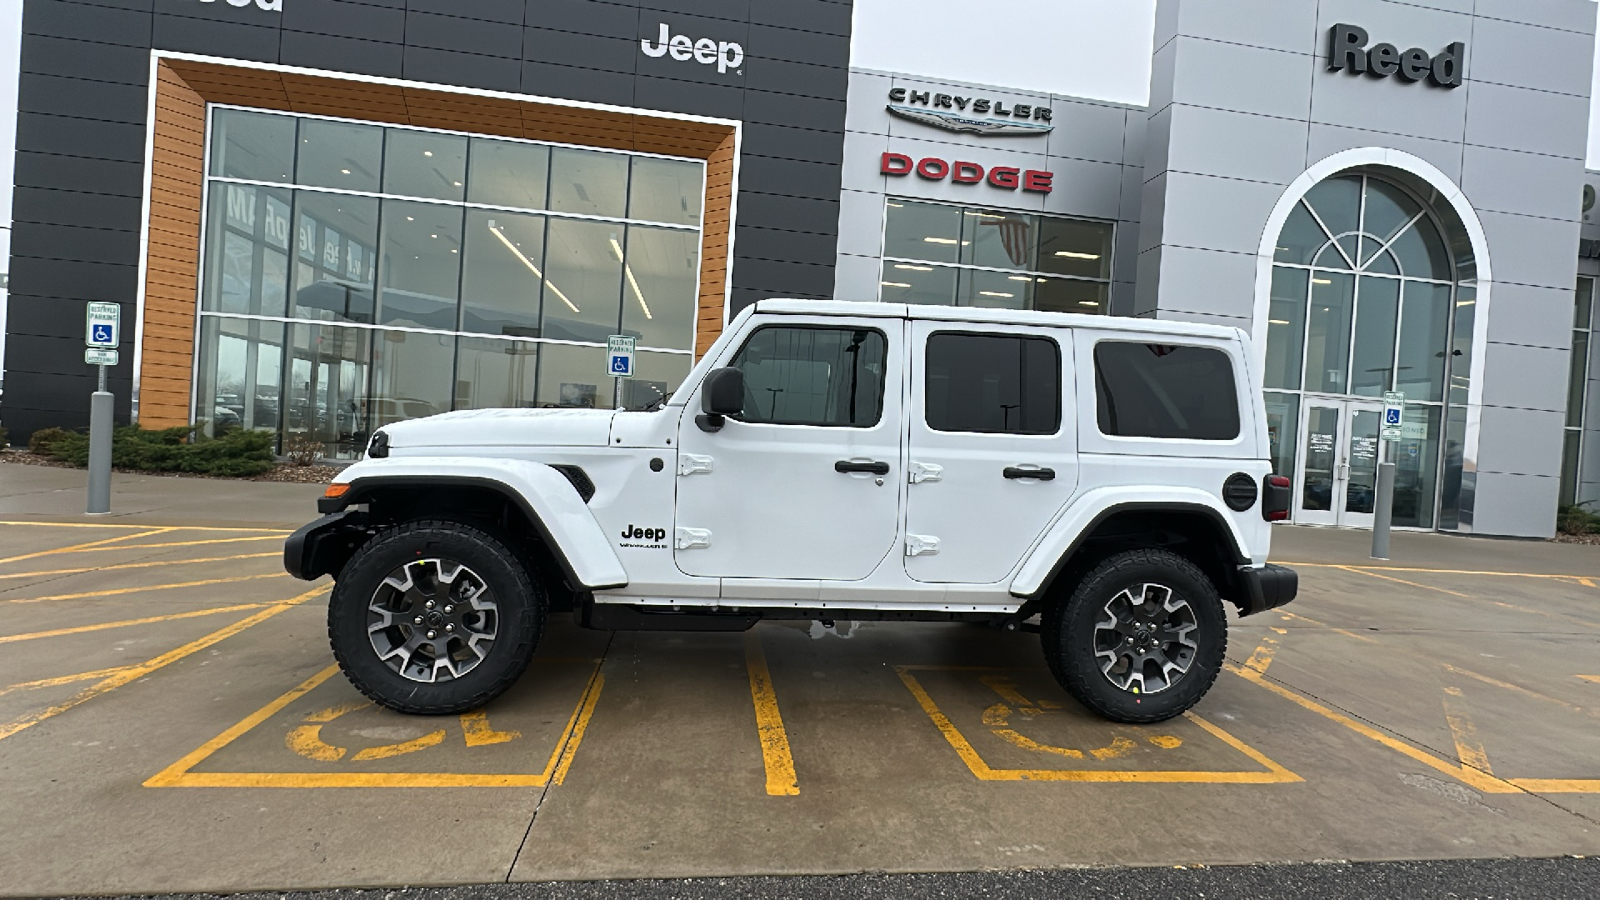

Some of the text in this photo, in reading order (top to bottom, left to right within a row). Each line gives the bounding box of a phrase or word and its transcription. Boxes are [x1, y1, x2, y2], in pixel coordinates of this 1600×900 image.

[641, 23, 744, 73] Jeep
[1328, 23, 1465, 89] Reed
[888, 87, 1053, 121] CHRYSLER
[880, 151, 1054, 193] DODGE
[90, 313, 117, 321] PARKING
[91, 306, 116, 314] RESERVED
[621, 524, 666, 542] Jeep
